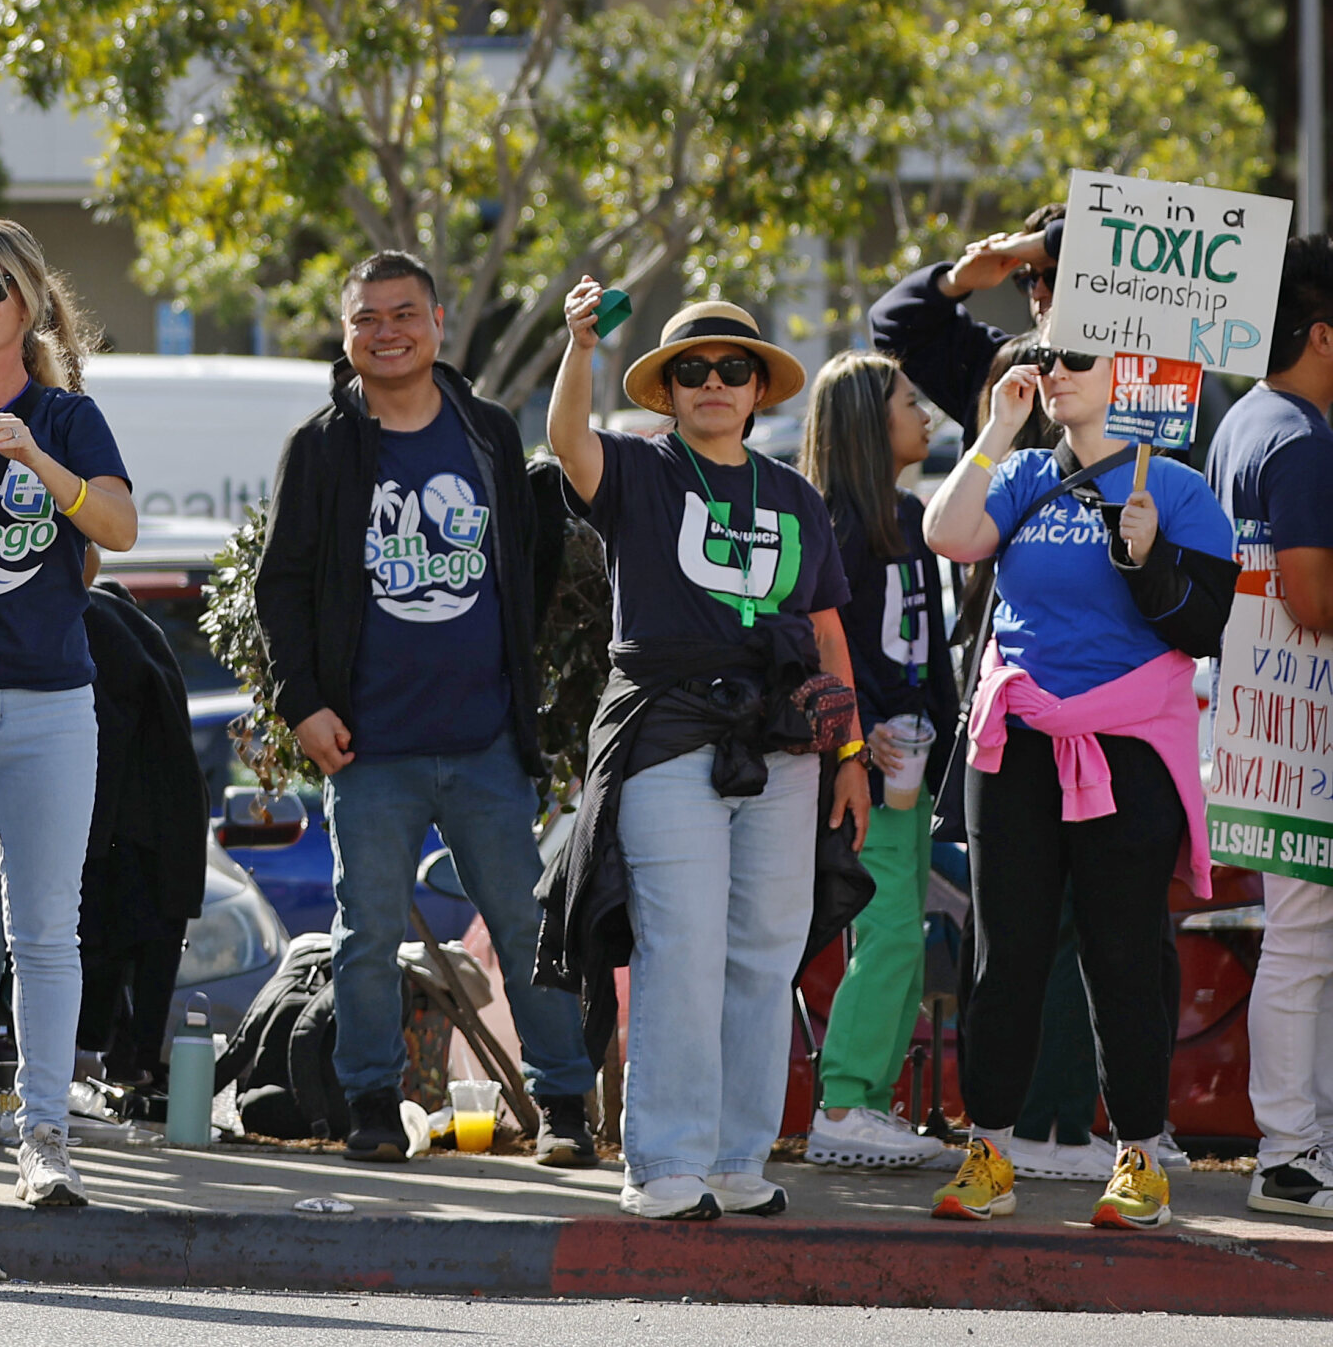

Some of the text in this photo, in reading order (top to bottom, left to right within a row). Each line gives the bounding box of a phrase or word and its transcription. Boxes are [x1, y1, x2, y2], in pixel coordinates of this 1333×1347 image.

[1088, 183, 1245, 229] I'm in a
[1101, 217, 1242, 283] TOXIC
[1075, 269, 1228, 325] relationship
[1083, 316, 1261, 368] with KP
[1116, 357, 1157, 384] ULP
[1114, 384, 1188, 412] STRIKE
[1072, 503, 1104, 524] AR
[365, 529, 426, 565] San
[379, 553, 485, 591] Diego
[1211, 747, 1304, 809] HUMANS
[1211, 820, 1275, 861] FIRST!
